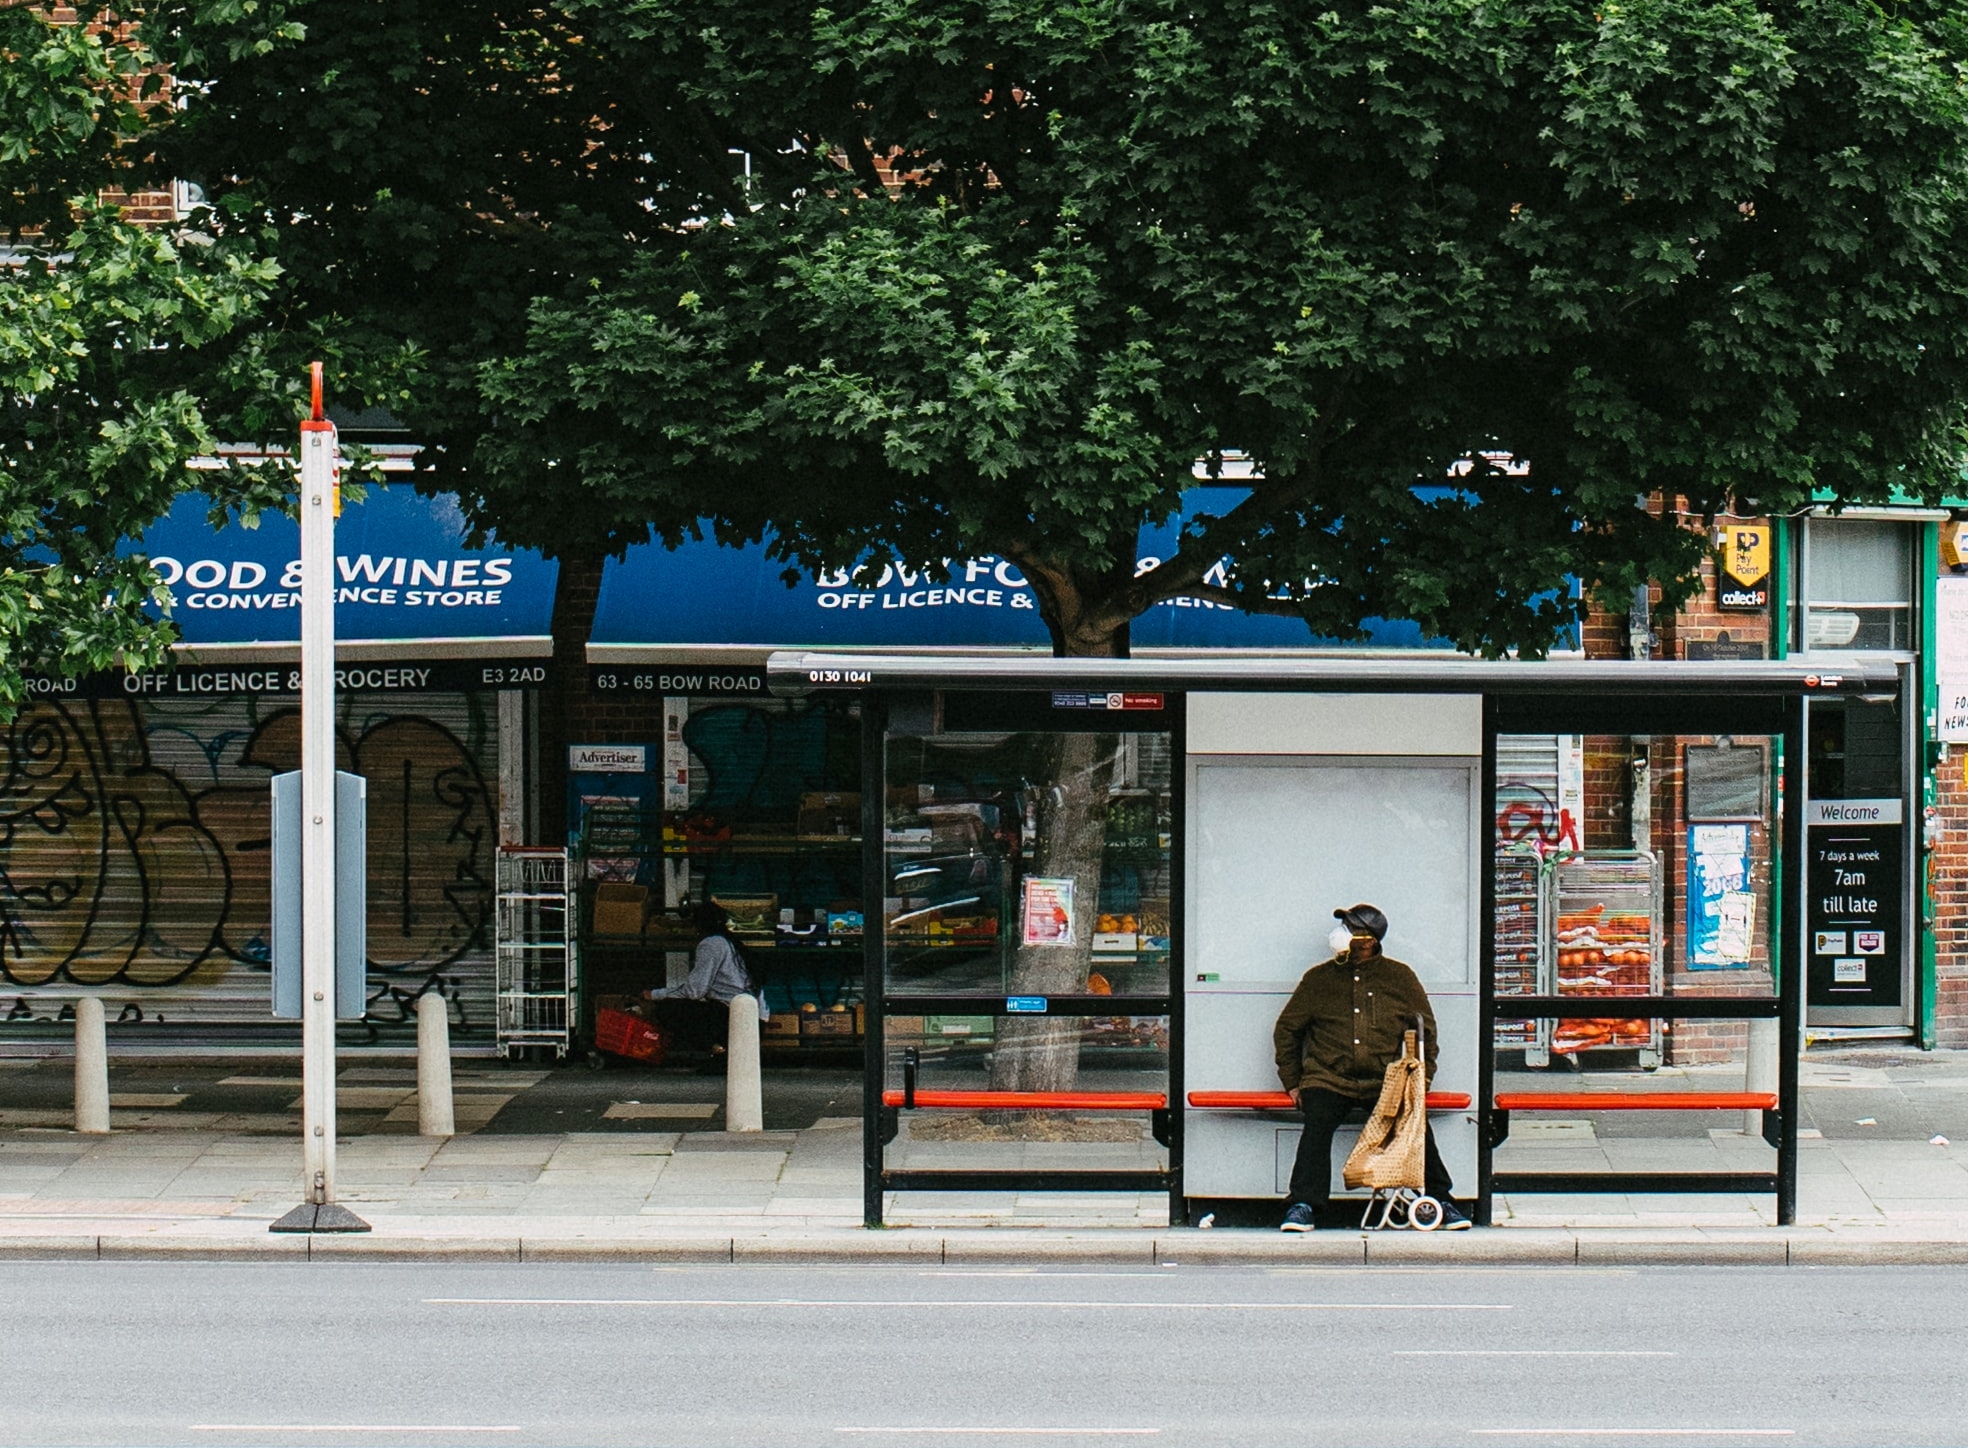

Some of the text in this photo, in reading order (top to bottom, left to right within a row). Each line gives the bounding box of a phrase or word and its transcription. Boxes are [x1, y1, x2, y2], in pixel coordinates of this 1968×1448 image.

[149, 556, 267, 589] OOD
[336, 554, 513, 587] WINES
[1736, 565, 1759, 575] Point
[186, 586, 397, 609] CONVENNCE
[404, 589, 502, 607] STORE
[817, 588, 1034, 609] OFF LICENCE &
[123, 668, 431, 693] OFF LICENCE & ROCERY
[482, 667, 546, 683] E3 2AD
[597, 675, 617, 689] 63
[633, 675, 654, 689] 65
[659, 675, 703, 690] BOW
[708, 675, 761, 690] ROAD
[809, 670, 872, 683] 0130 1041
[25, 678, 77, 692] ROAD
[1954, 697, 1968, 710] FO
[580, 751, 638, 763] Advertiser
[1820, 805, 1880, 819] Welcome
[1819, 850, 1880, 863] 7 days a week
[1834, 868, 1865, 886] 7am
[1823, 895, 1878, 913] till late
